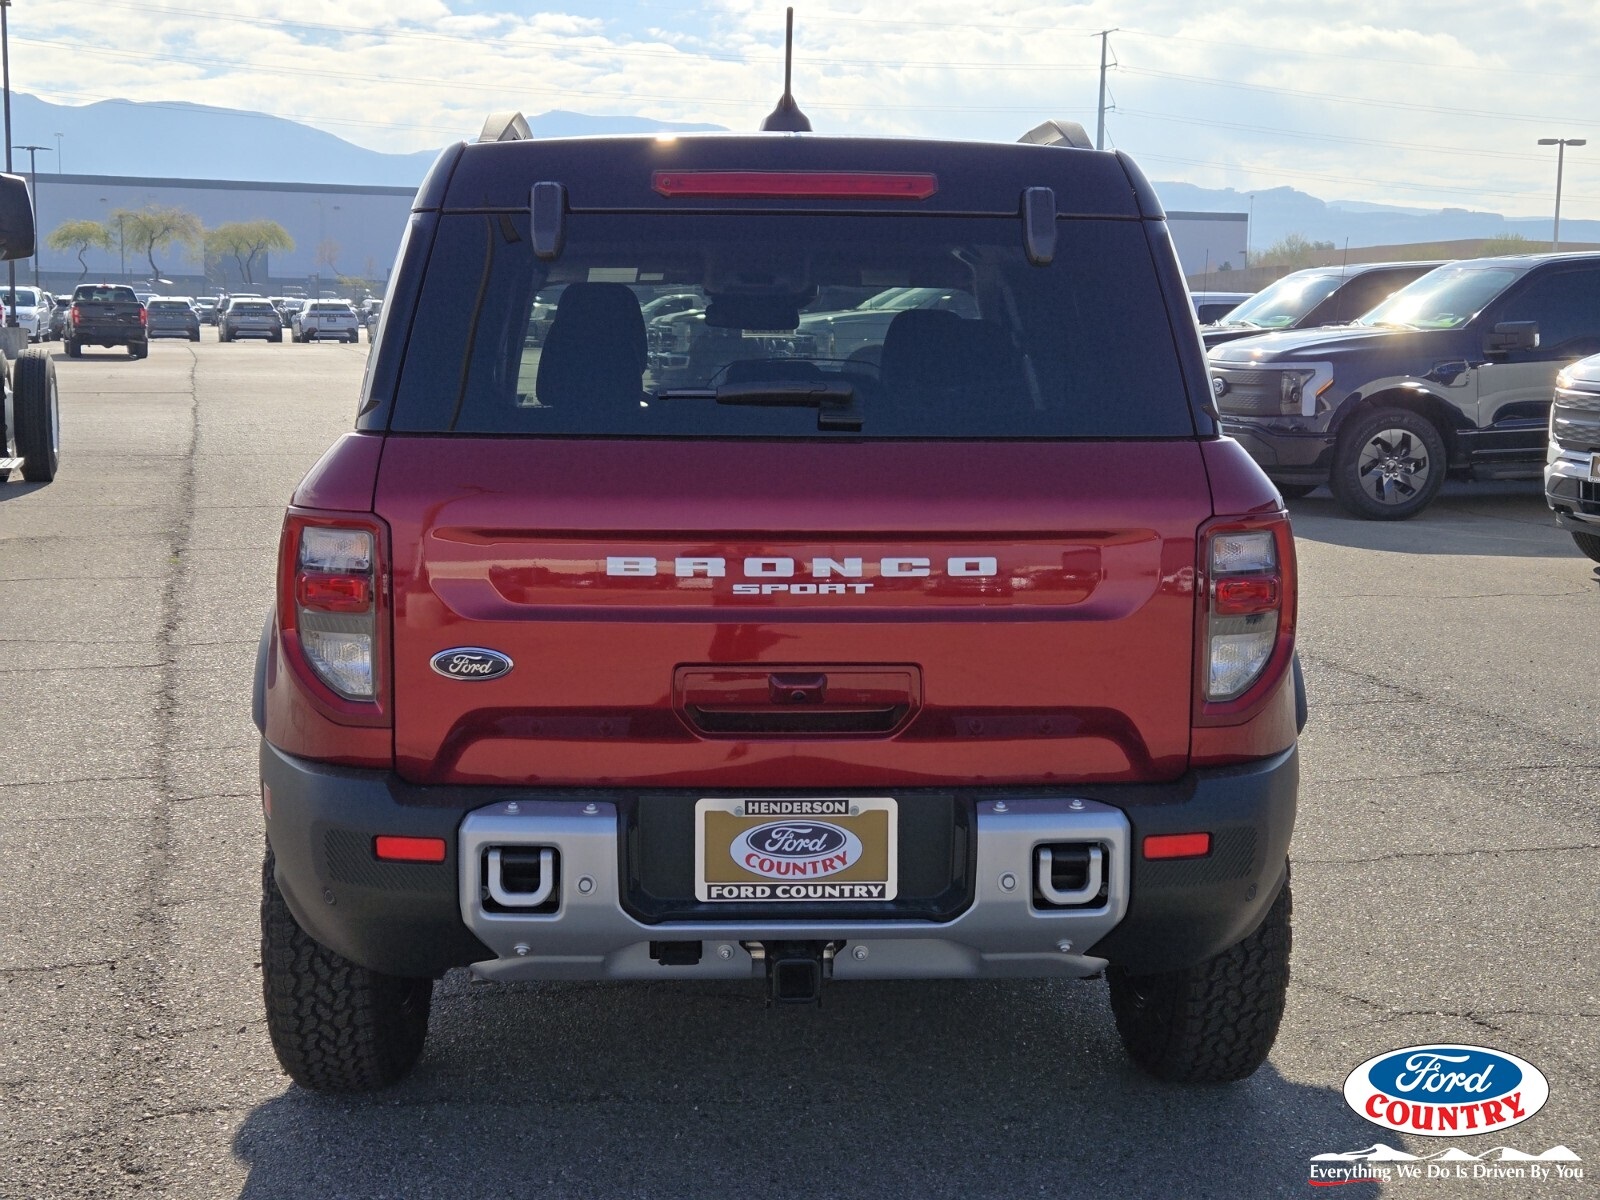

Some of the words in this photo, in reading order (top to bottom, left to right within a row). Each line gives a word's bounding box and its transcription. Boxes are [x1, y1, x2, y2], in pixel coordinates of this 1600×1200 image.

[606, 556, 998, 577] BRONCO
[732, 583, 874, 595] SPORT
[448, 654, 494, 674] Ford
[747, 801, 846, 814] HENDERSON
[764, 826, 829, 852] Ford
[744, 850, 849, 876] COUNTRY
[710, 885, 771, 899] FORD
[775, 884, 883, 899] COUNTRY
